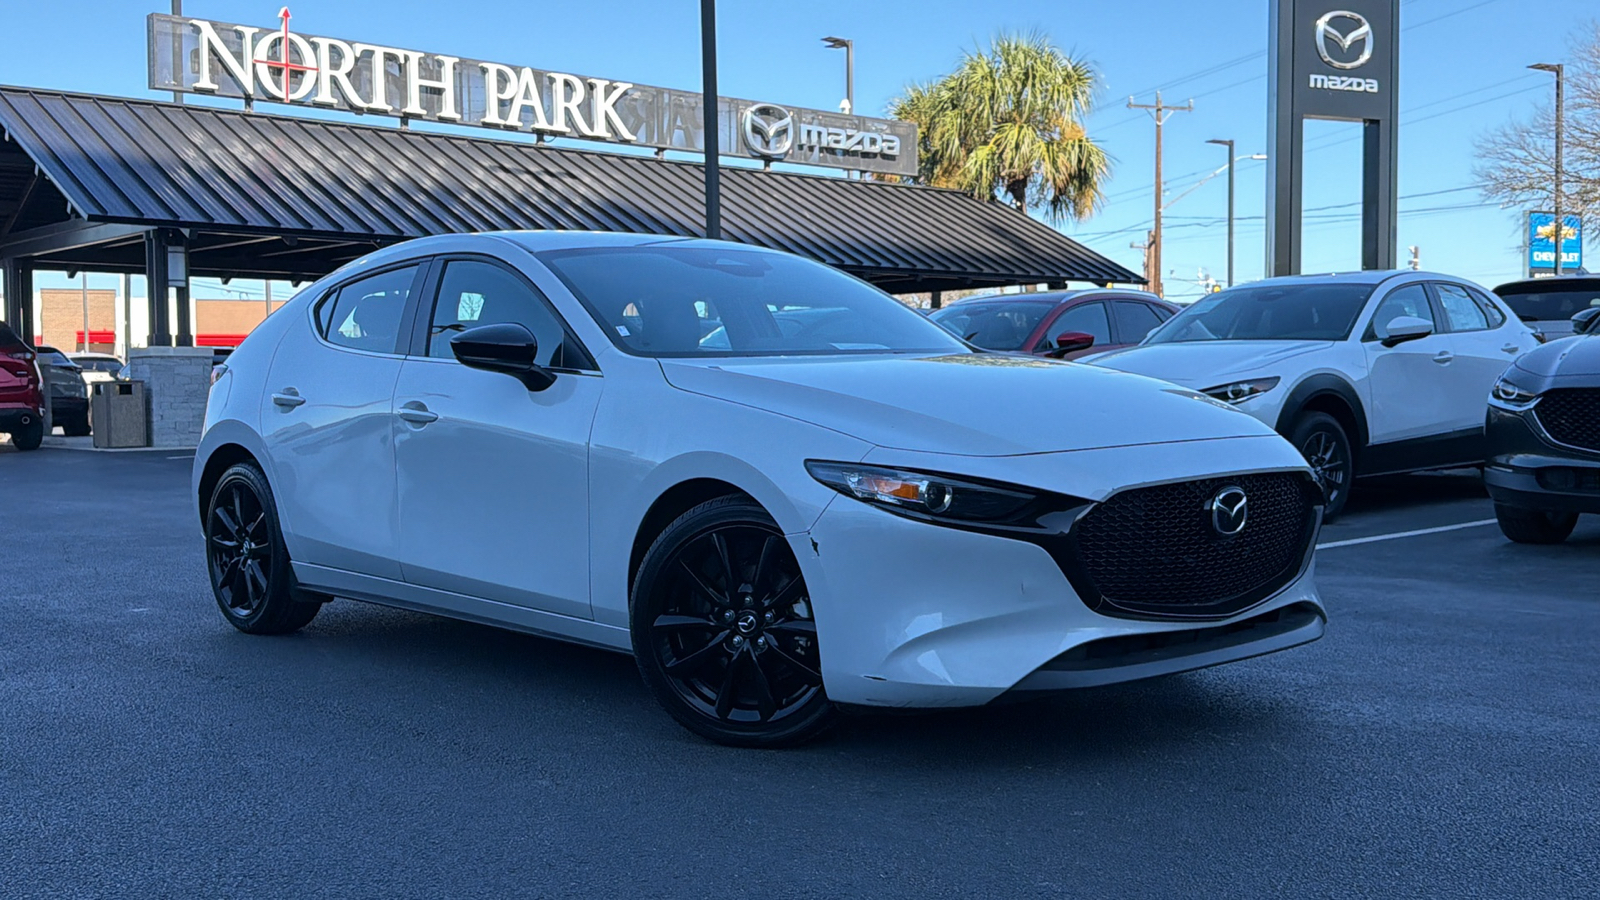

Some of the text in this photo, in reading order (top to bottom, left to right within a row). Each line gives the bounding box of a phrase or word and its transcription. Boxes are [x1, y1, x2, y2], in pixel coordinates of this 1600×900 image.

[190, 19, 637, 142] NORTH PARK
[1309, 74, 1379, 93] mazda
[800, 123, 900, 156] mazda
[1533, 251, 1579, 262] CHEVOLET
